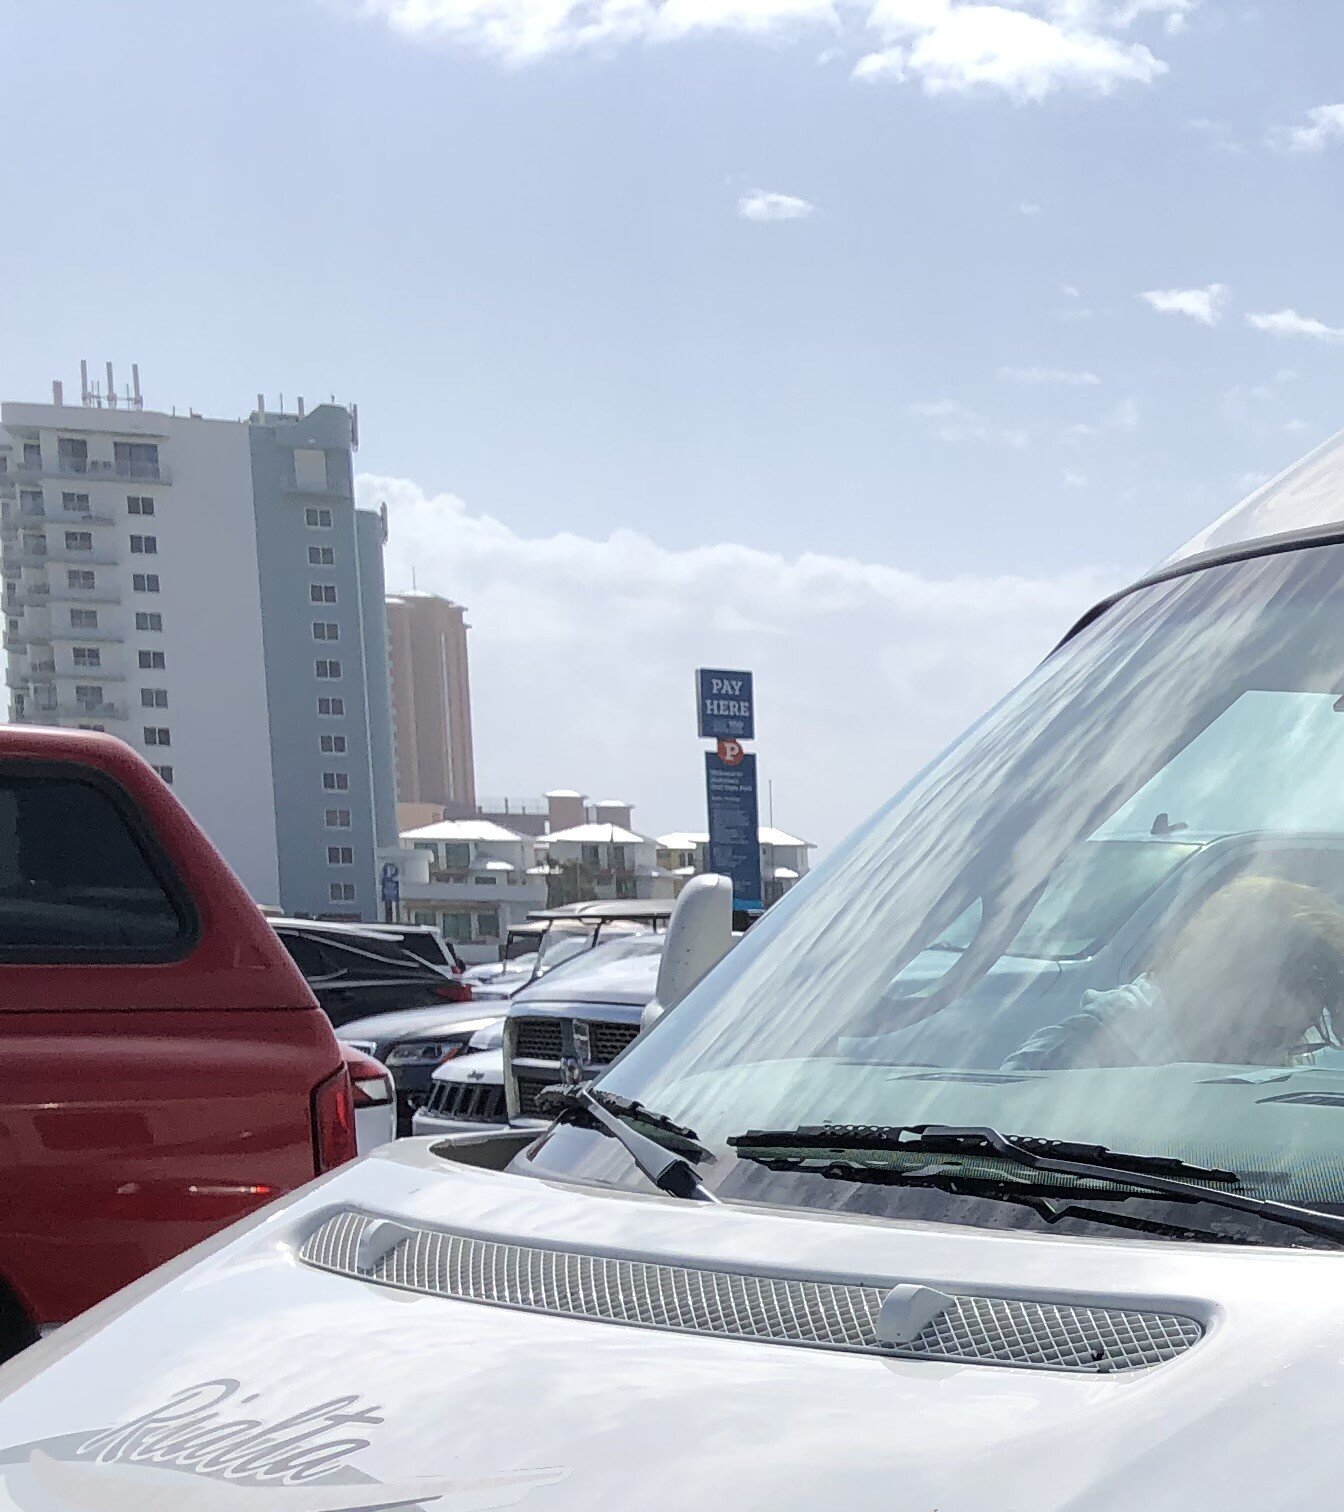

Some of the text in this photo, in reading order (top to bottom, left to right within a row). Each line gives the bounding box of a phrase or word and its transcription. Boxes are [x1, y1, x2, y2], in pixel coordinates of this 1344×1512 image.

[711, 678, 743, 696] PAY
[705, 699, 750, 717] HERE
[724, 741, 740, 760] P
[77, 1377, 386, 1485] Rialto
